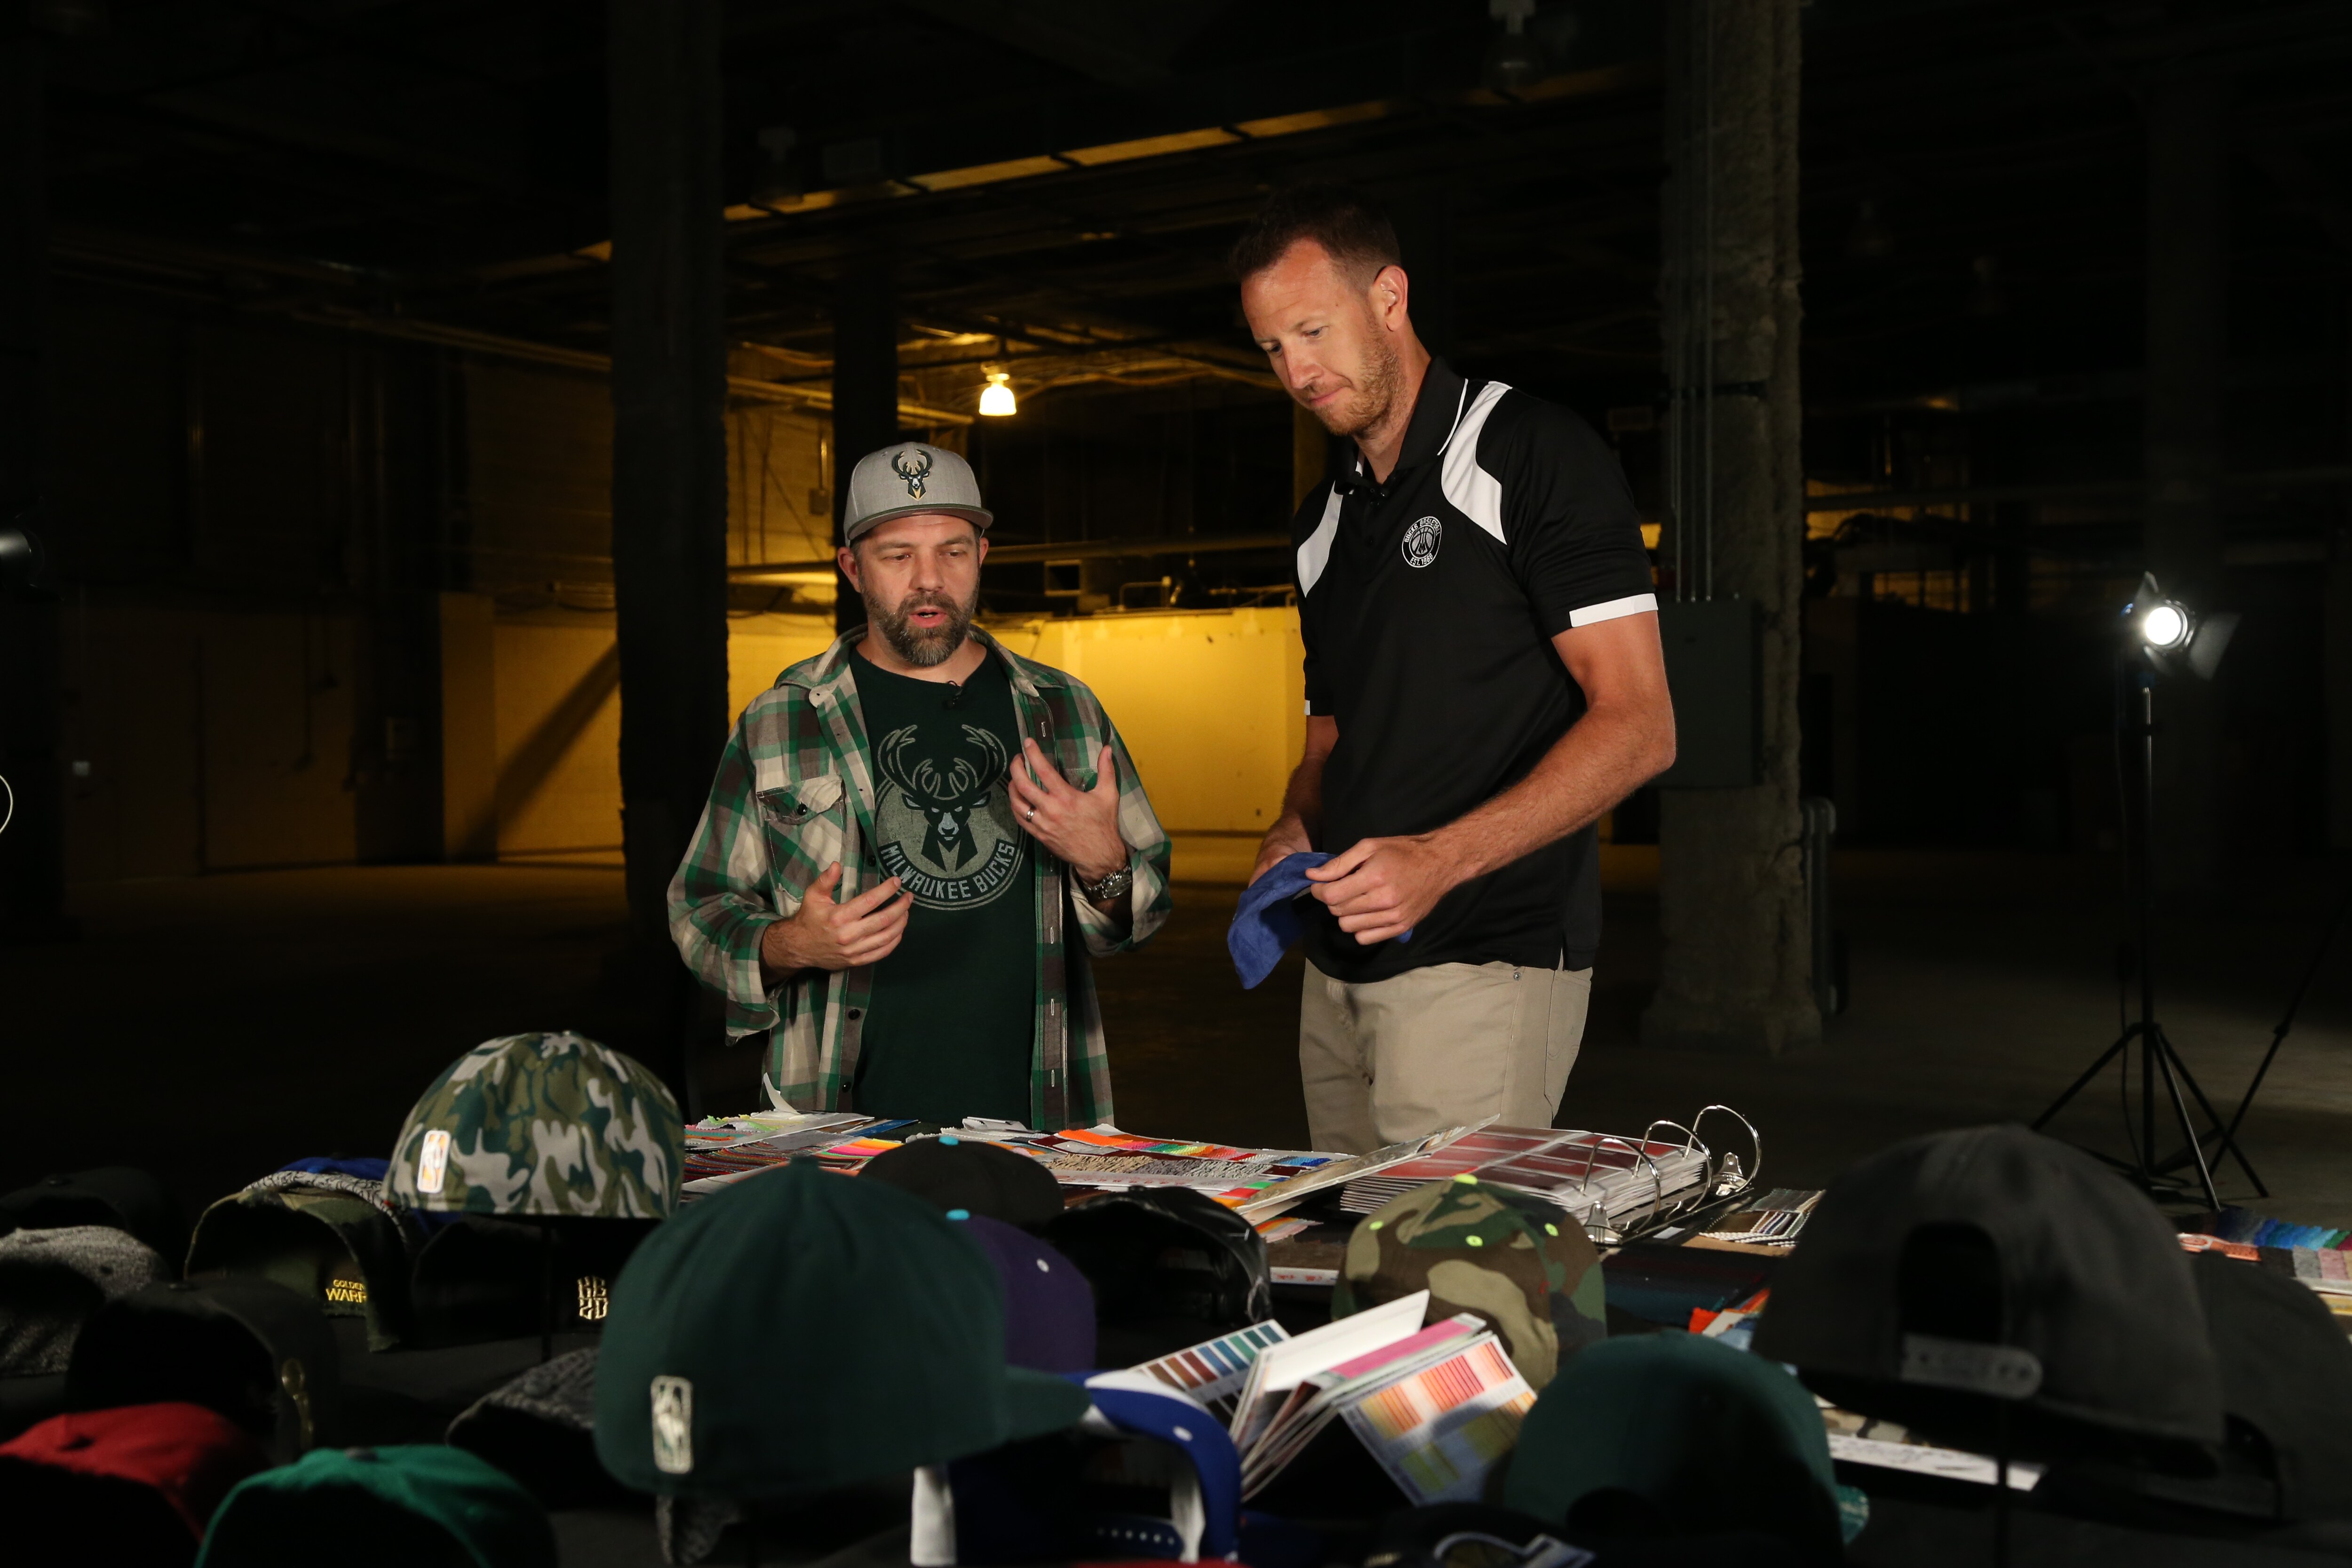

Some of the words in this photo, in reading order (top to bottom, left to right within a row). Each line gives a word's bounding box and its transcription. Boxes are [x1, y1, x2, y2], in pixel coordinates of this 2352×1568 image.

[1404, 523, 1419, 543] BUCKS
[1410, 557, 1420, 566] EST.
[1422, 552, 1434, 565] 1968
[880, 844, 971, 899] MILWAUKEE
[972, 842, 1015, 893] BUCKS
[333, 1279, 366, 1291] GOLDEN
